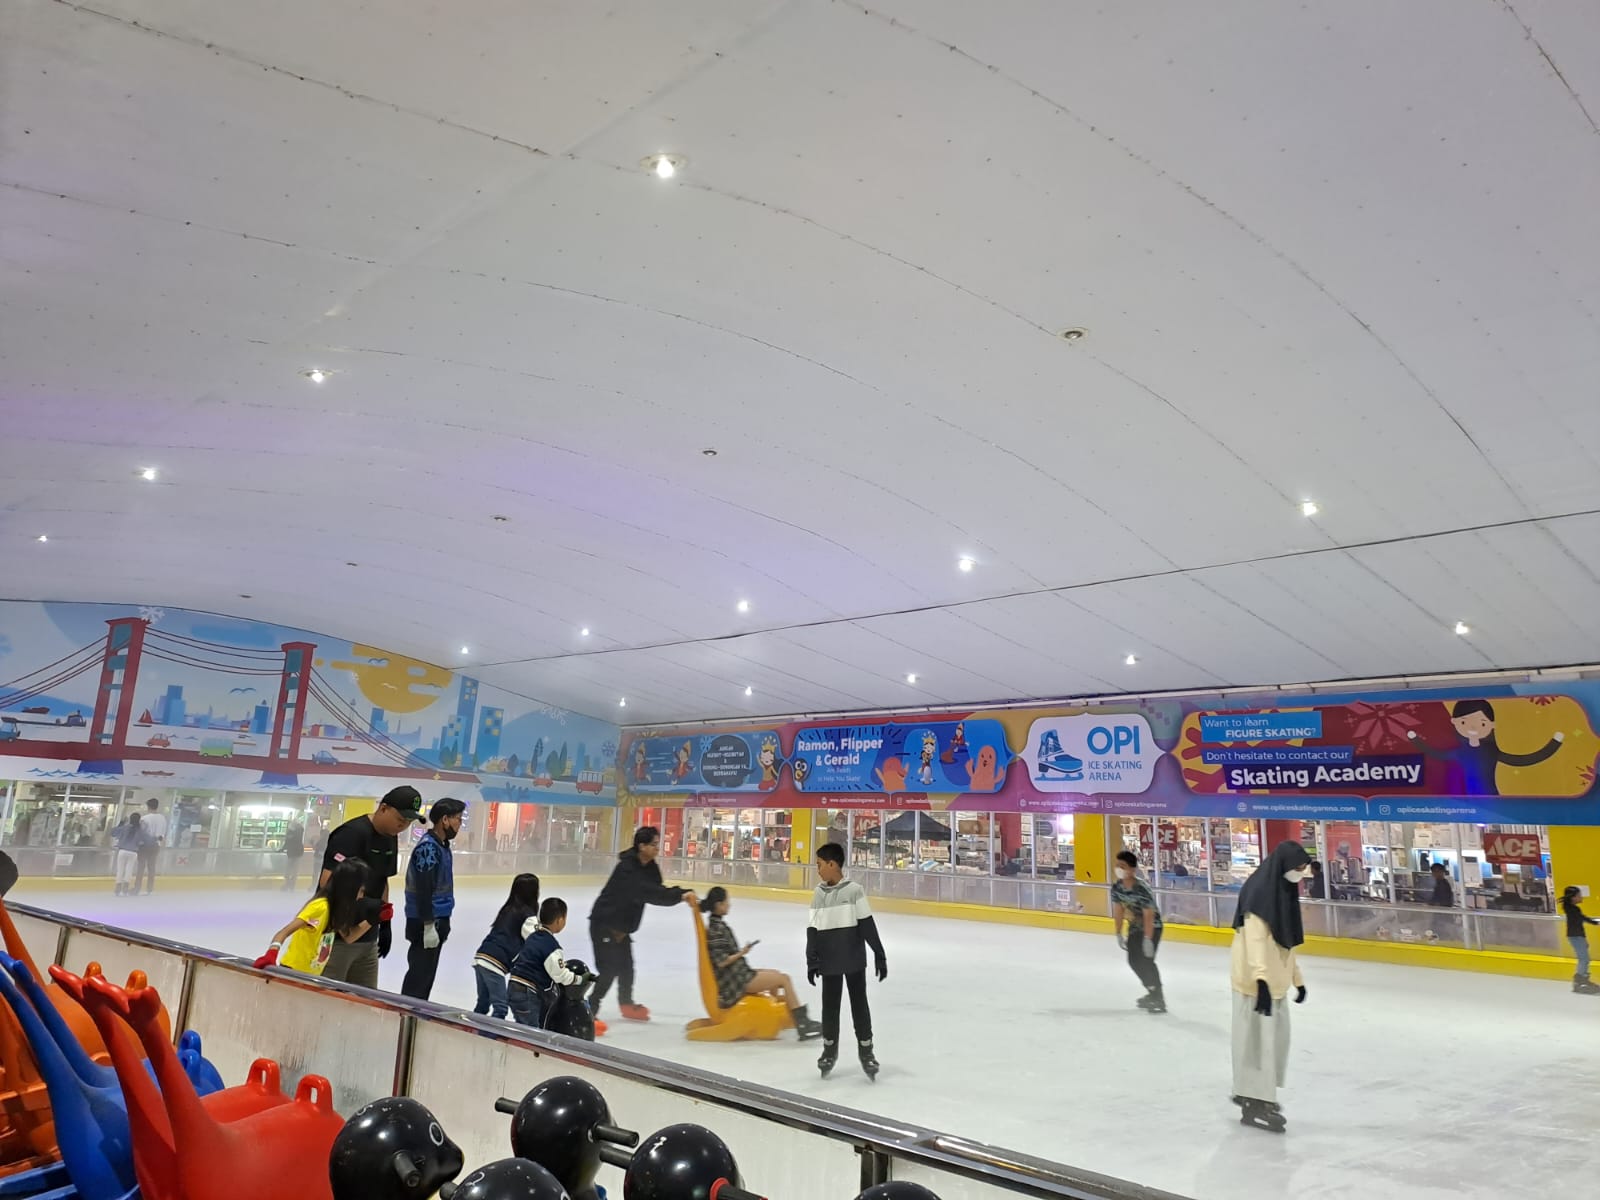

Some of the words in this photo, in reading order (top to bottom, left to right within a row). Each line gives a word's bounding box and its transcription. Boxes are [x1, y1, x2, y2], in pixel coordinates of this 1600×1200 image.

[1205, 719, 1228, 727] Want
[1229, 719, 1242, 727] to
[1244, 718, 1269, 727] learn
[1226, 729, 1263, 738] FIGURE
[1265, 727, 1317, 738] SKATING?
[798, 741, 839, 752] Ramon,
[841, 737, 883, 752] Flipper
[1087, 726, 1140, 754] OPI
[816, 755, 822, 766] &
[824, 753, 860, 765] Gerald
[1206, 751, 1232, 761] Don't
[1235, 751, 1273, 760] hesitate
[1276, 752, 1287, 760] to
[1288, 751, 1328, 760] contact
[1331, 752, 1349, 760] our
[1088, 761, 1100, 770] ICE
[1101, 760, 1142, 770] SKATING
[1089, 771, 1122, 781] ARENA
[1231, 766, 1309, 787] Skating
[1315, 762, 1421, 783] Academy
[1486, 836, 1537, 857] ACE
